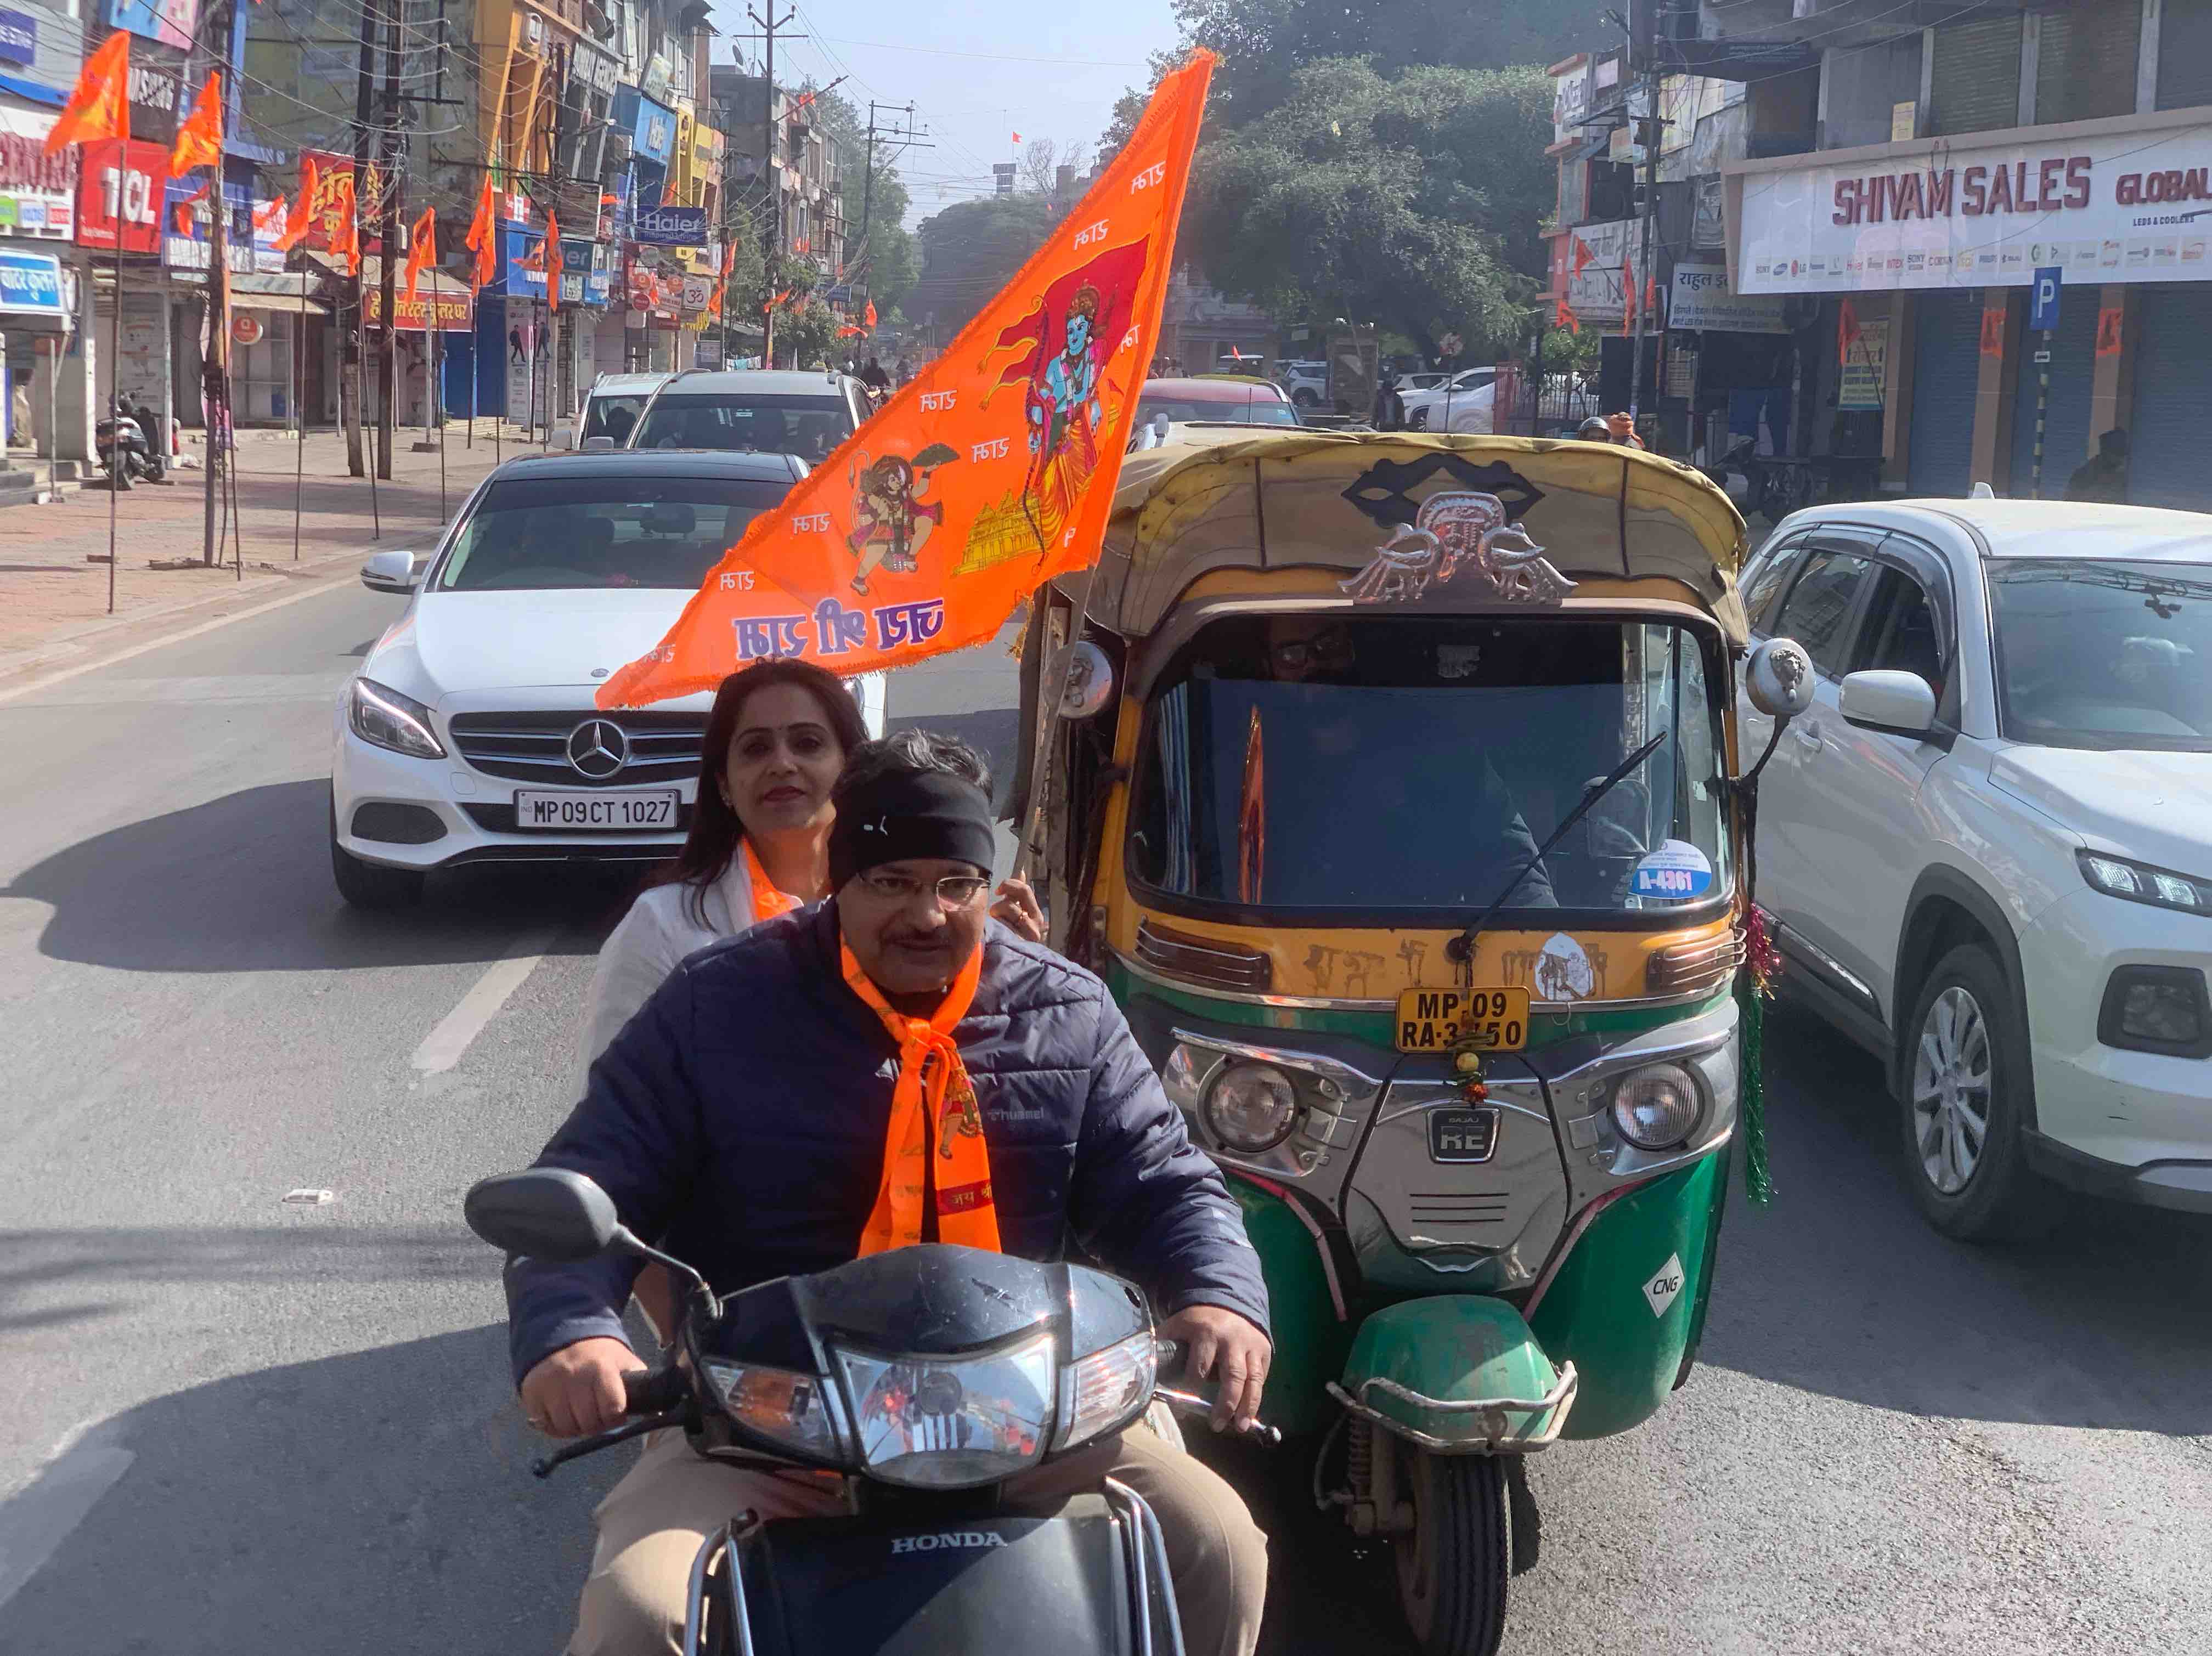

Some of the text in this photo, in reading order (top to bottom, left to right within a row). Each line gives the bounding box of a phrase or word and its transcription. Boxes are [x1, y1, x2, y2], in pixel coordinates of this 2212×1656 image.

[101, 166, 156, 224] TCL
[1832, 157, 2092, 225] SHIVAM SALES
[2115, 167, 2212, 205] GLOBAL
[646, 214, 699, 231] Haier
[1679, 273, 1711, 291] राहुल
[2037, 278, 2055, 319] P
[623, 800, 671, 823] 1027
[1440, 1126, 1486, 1150] RE
[1653, 1276, 1679, 1295] CNG
[890, 1531, 1009, 1554] HONDA
